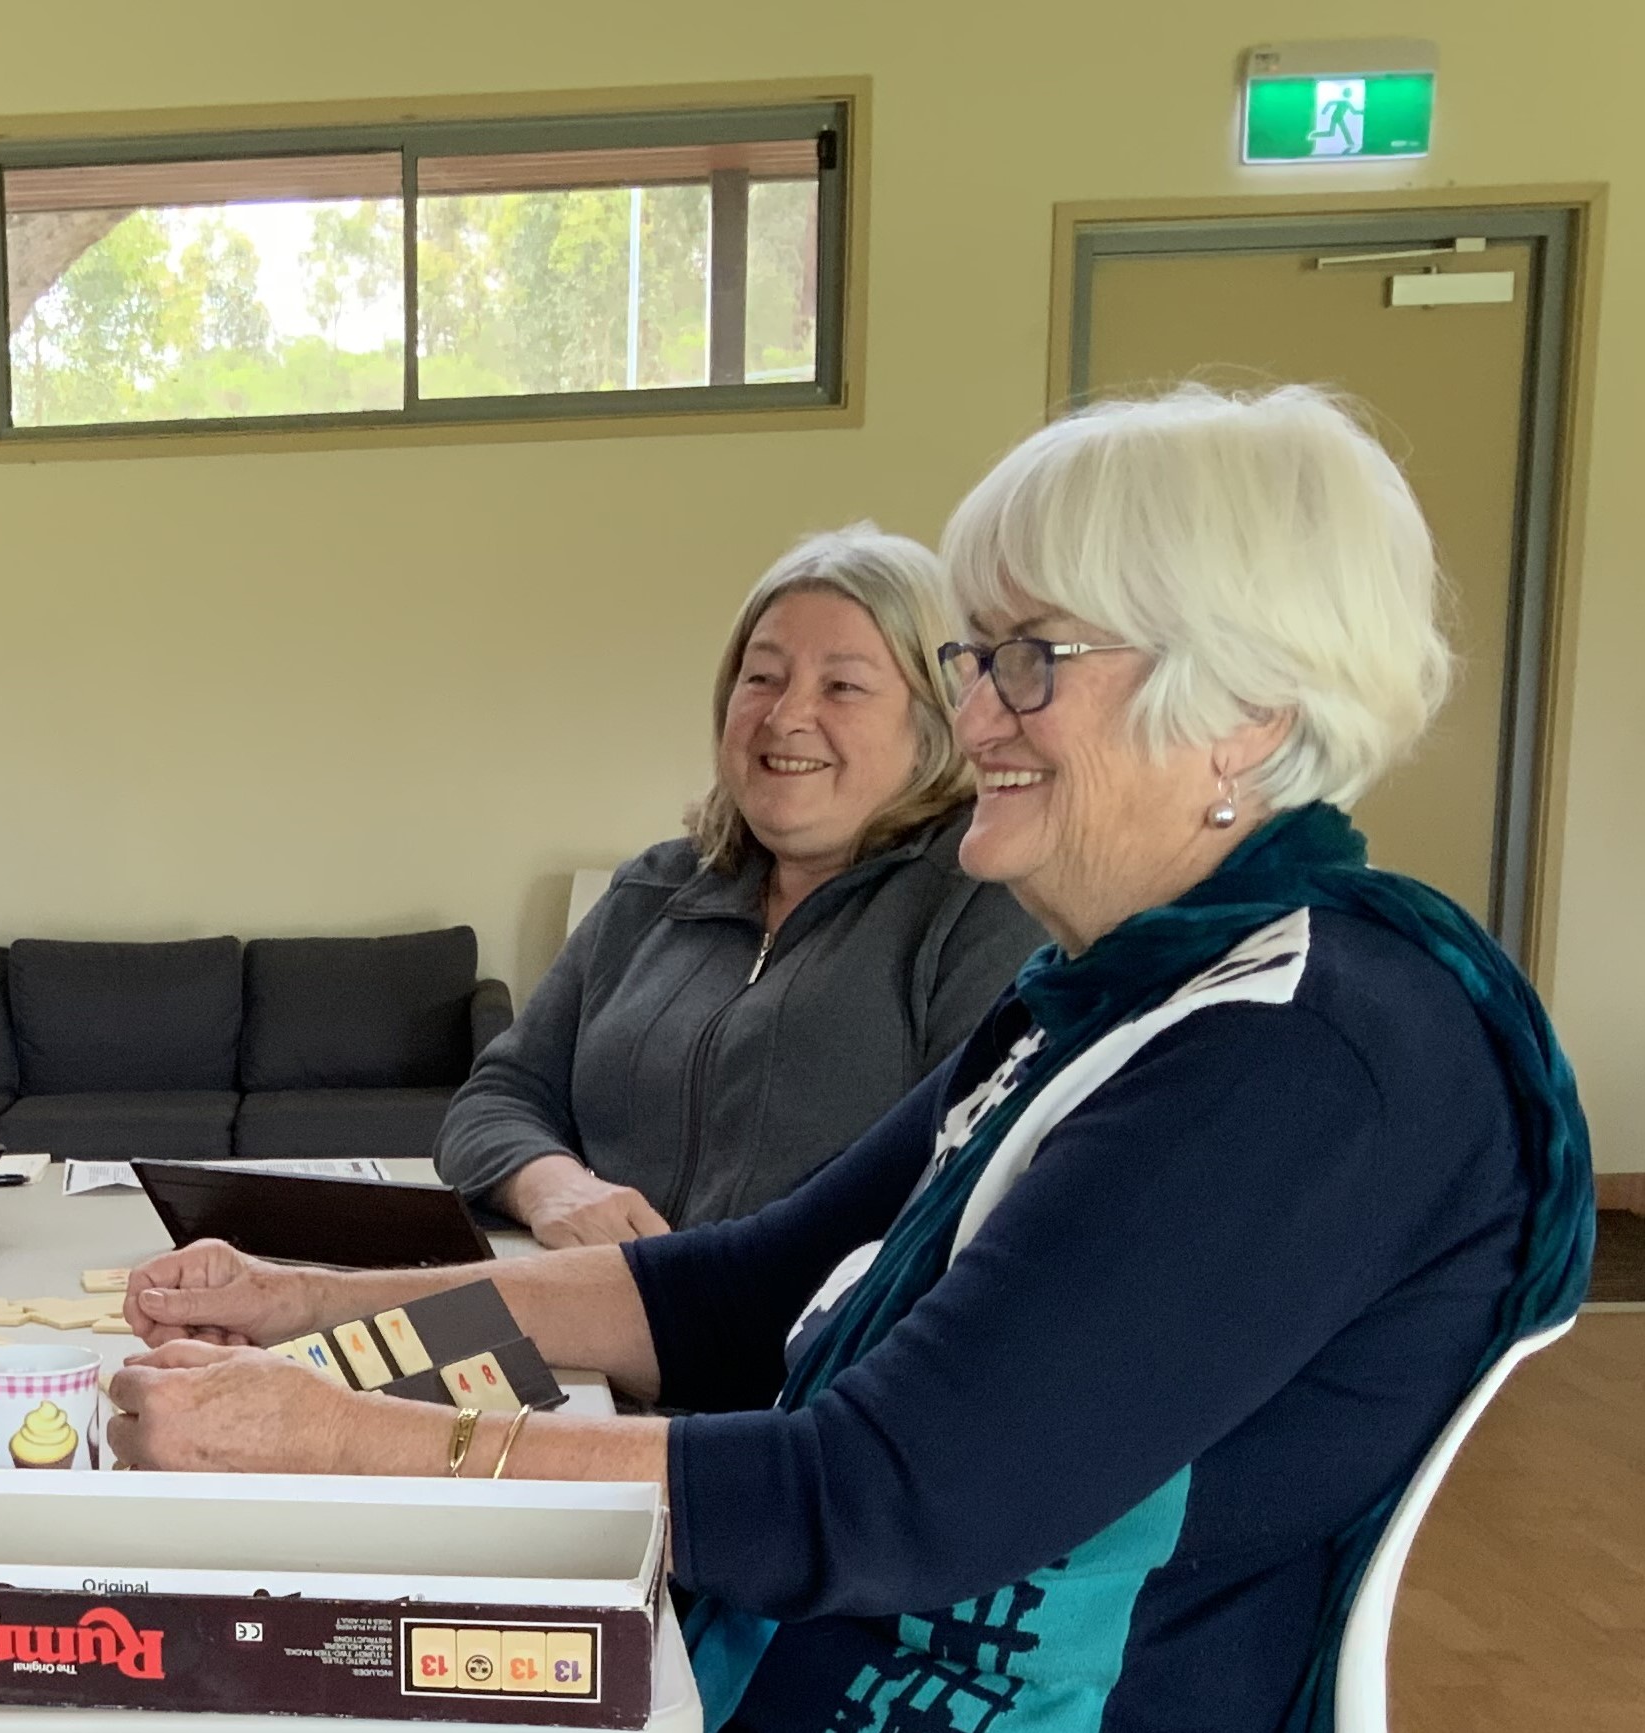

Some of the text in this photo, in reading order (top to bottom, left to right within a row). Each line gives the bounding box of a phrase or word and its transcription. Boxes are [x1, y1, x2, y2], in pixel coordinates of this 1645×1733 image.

[481, 1364, 497, 1385] 8
[13, 1661, 78, 1675] The Original
[421, 1654, 448, 1677] 13
[510, 1657, 538, 1680] 13
[554, 1659, 582, 1682] 13
